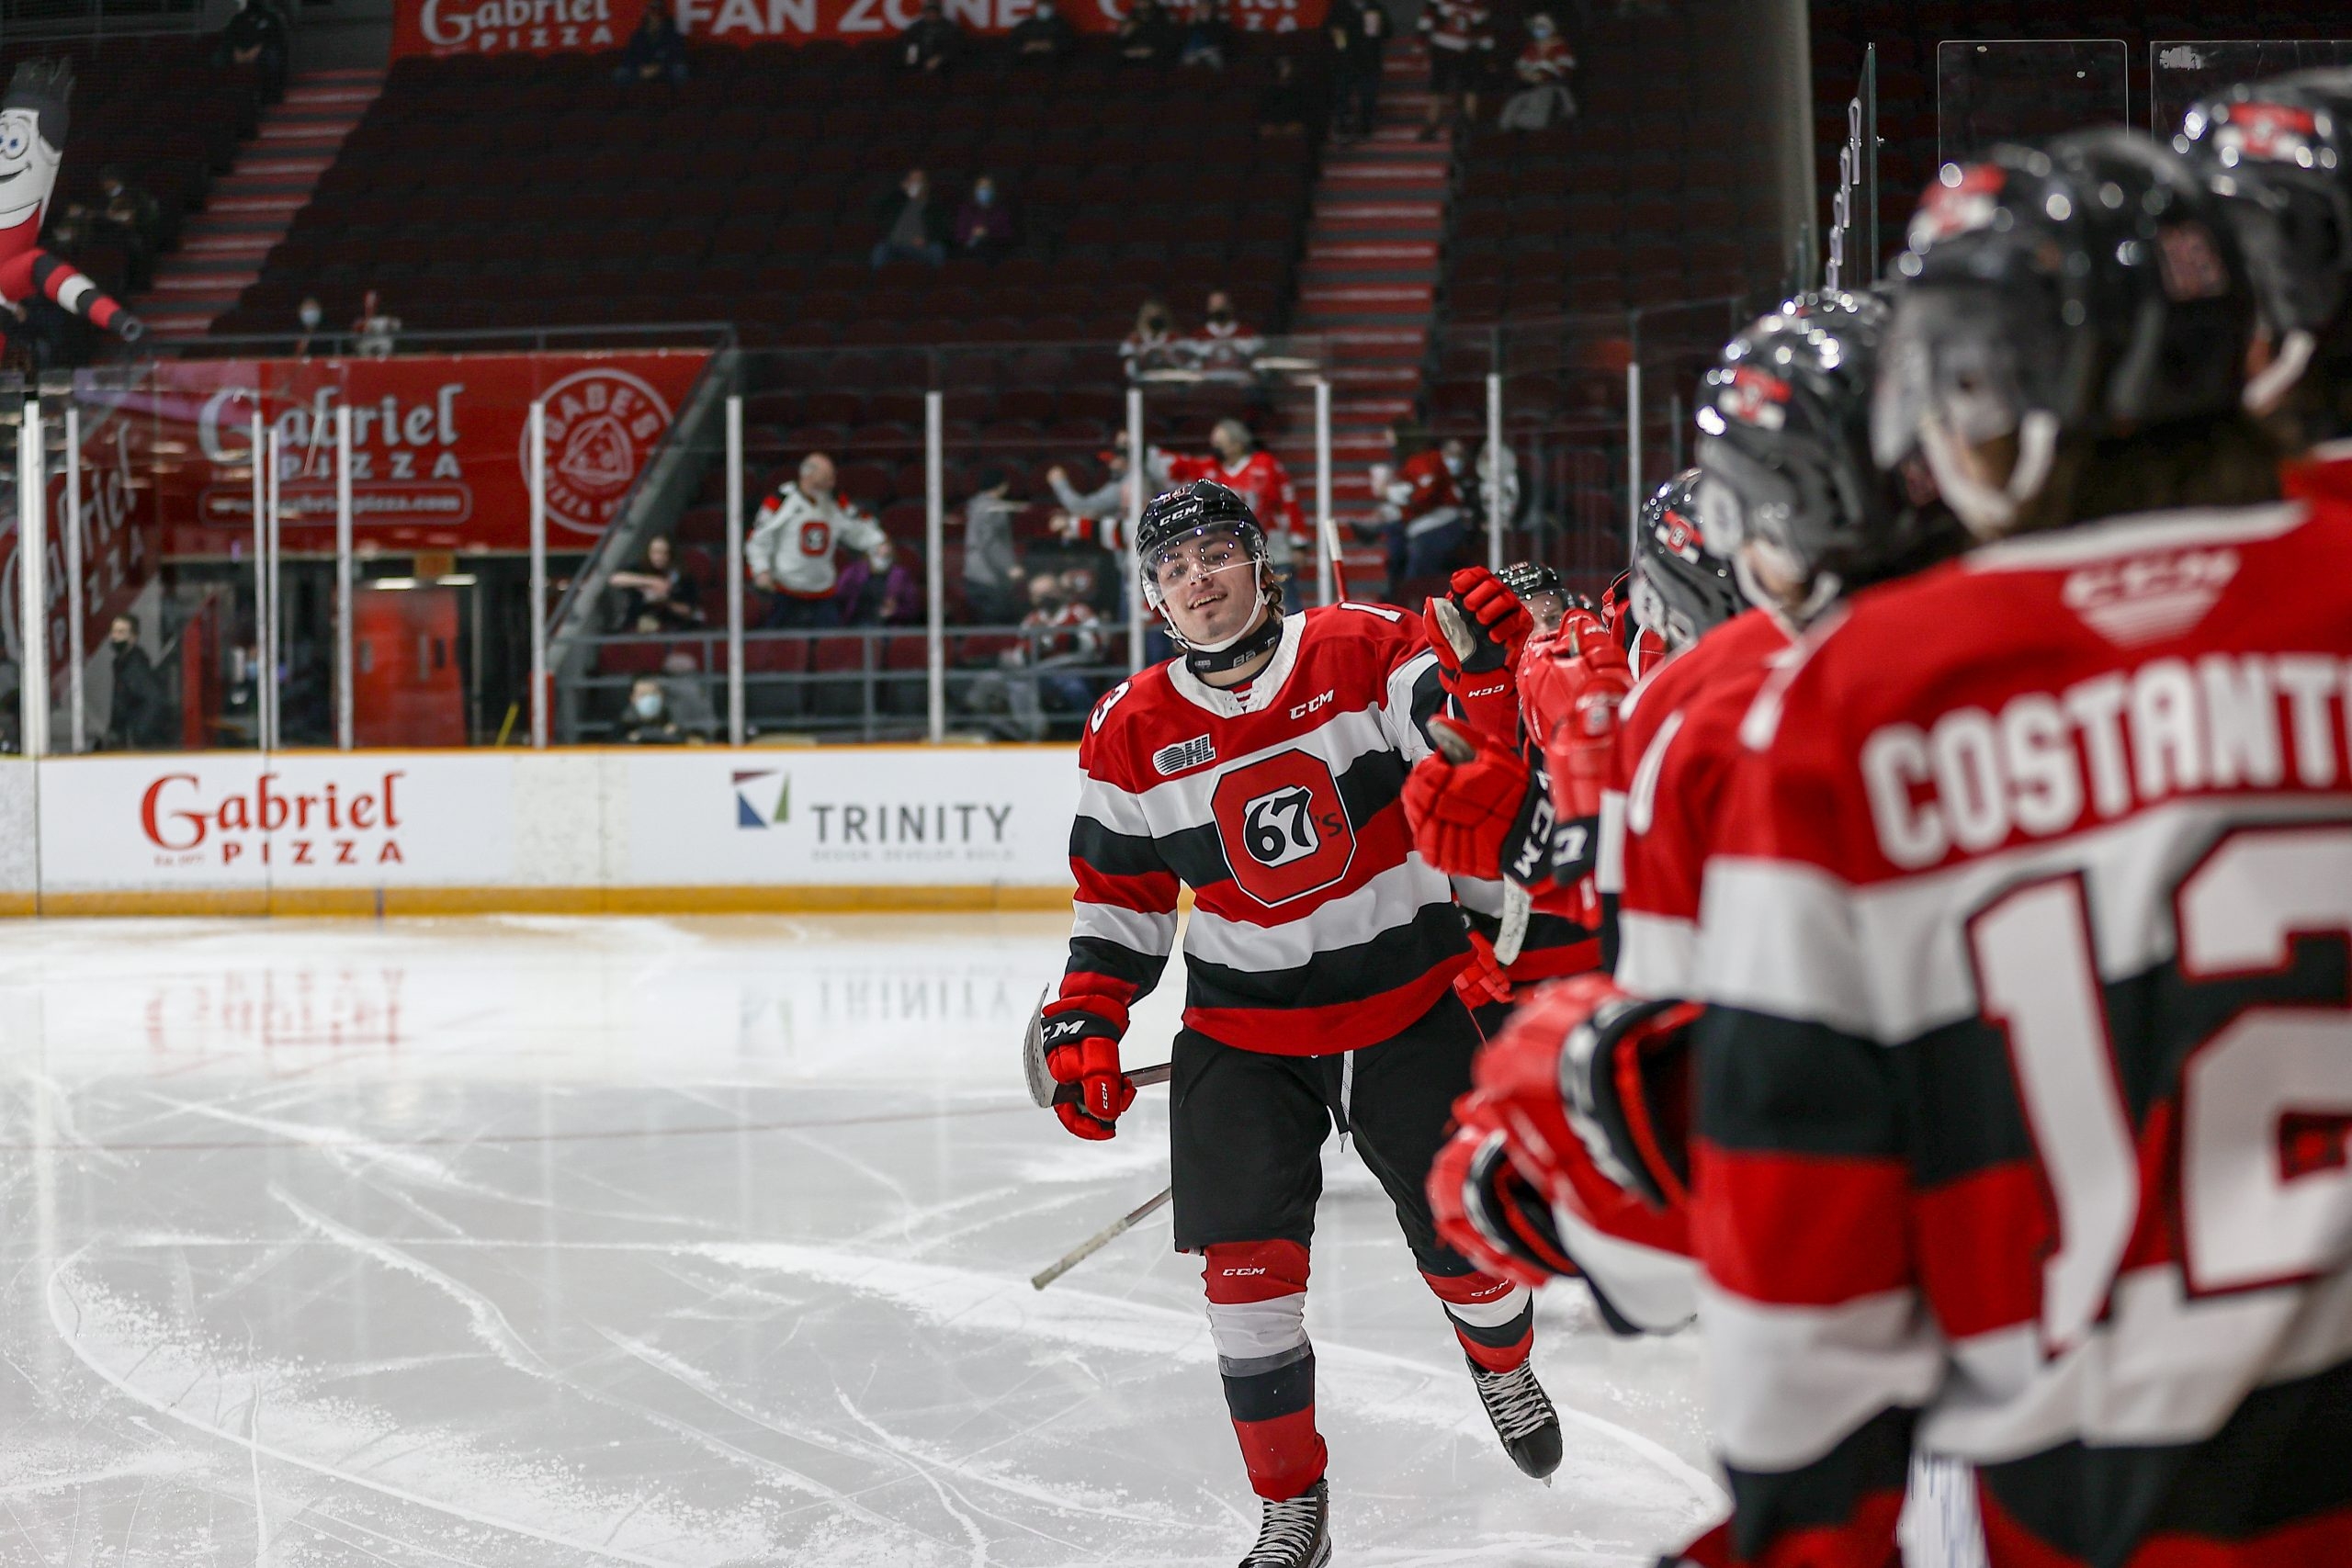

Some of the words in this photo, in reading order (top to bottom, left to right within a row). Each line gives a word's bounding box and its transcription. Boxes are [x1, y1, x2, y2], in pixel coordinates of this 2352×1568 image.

[674, 0, 817, 36] FAN
[479, 25, 614, 51] PIZZA
[198, 382, 465, 467] Gabriel
[277, 451, 461, 479] PIZZA
[1159, 502, 1198, 527] CCM
[1289, 689, 1334, 720] CCM
[1467, 683, 1505, 698] CCM
[1153, 733, 1216, 775] OHL
[1859, 653, 2352, 871] COSTANT
[141, 771, 407, 851] Gabriel
[810, 804, 1012, 843] TRINITY
[222, 840, 404, 865] PIZZA
[1222, 1267, 1266, 1277] CCM
[1471, 1278, 1510, 1298] CCM
